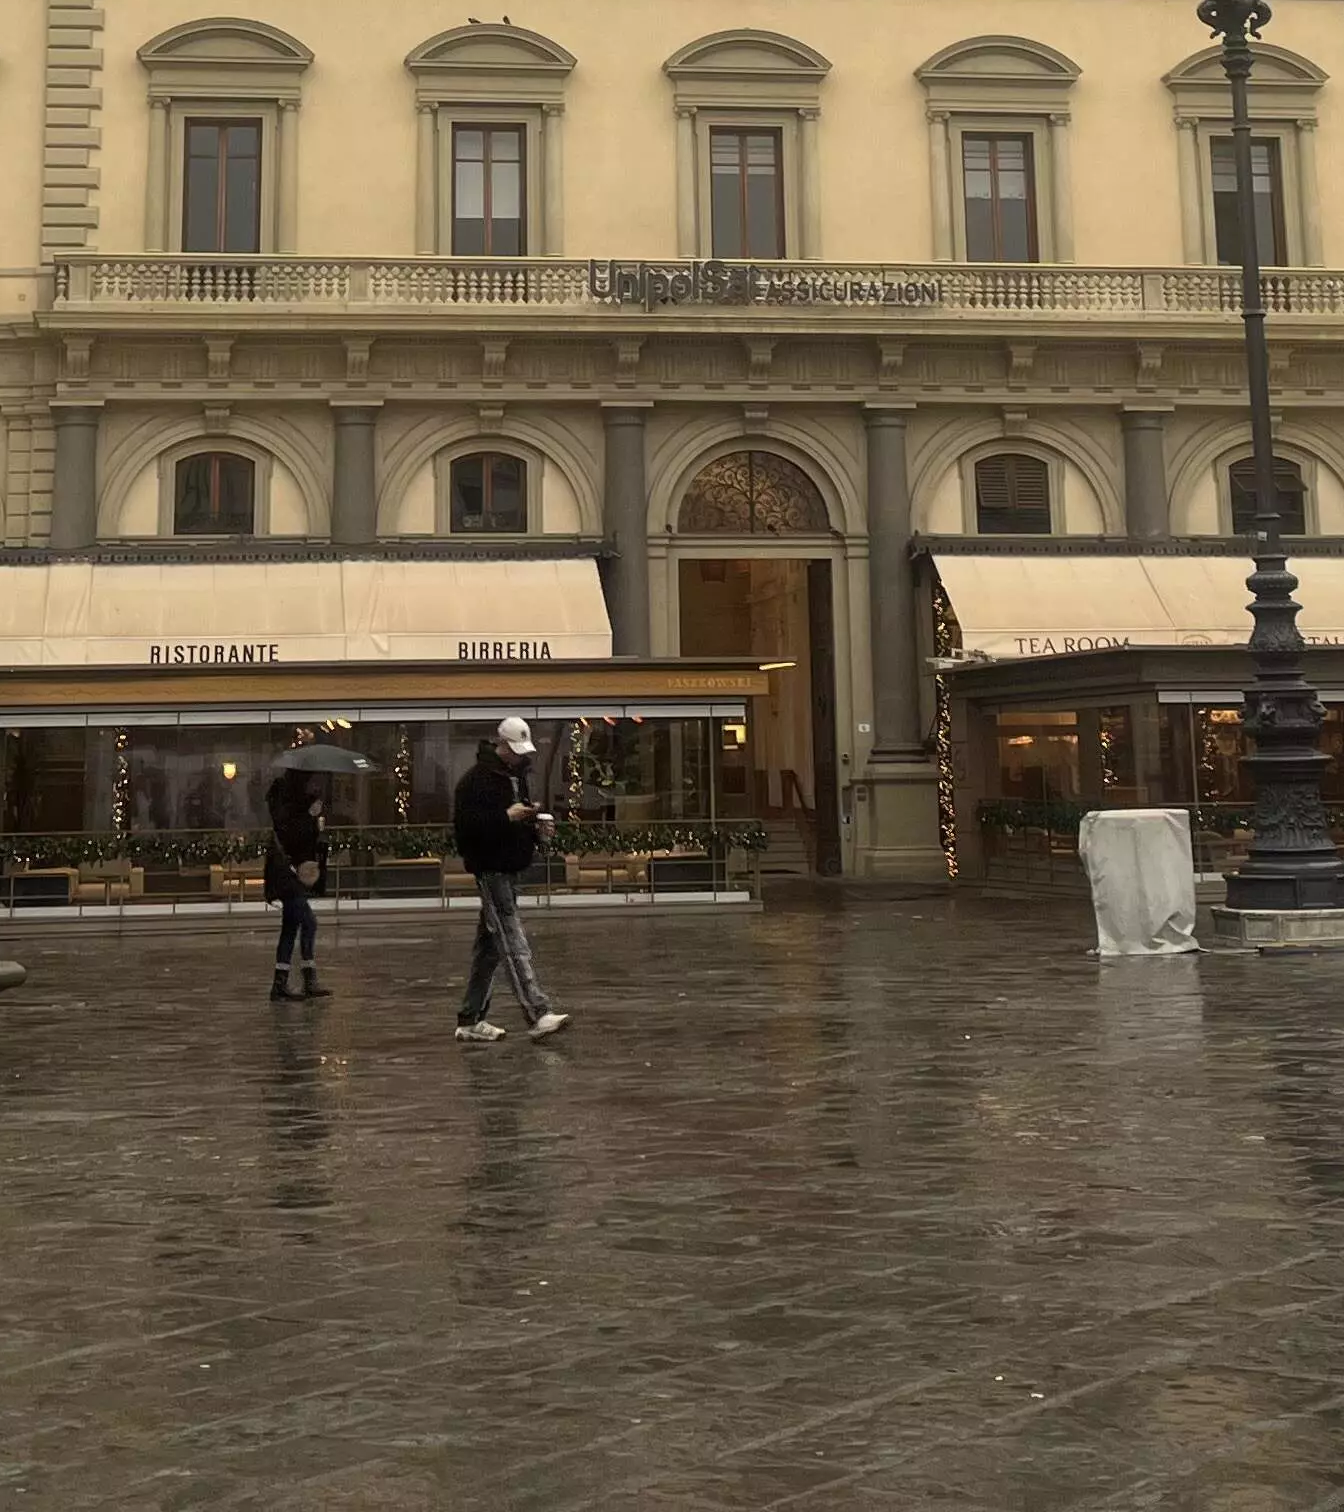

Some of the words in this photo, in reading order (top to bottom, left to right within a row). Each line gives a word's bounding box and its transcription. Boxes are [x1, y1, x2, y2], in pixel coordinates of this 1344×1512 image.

[764, 279, 945, 303] ASSICURAZIONI
[150, 643, 280, 665] RISTORANTE
[458, 641, 552, 660] BIRRERIA
[1014, 637, 1056, 655] TEA
[1066, 635, 1131, 653] ROOM
